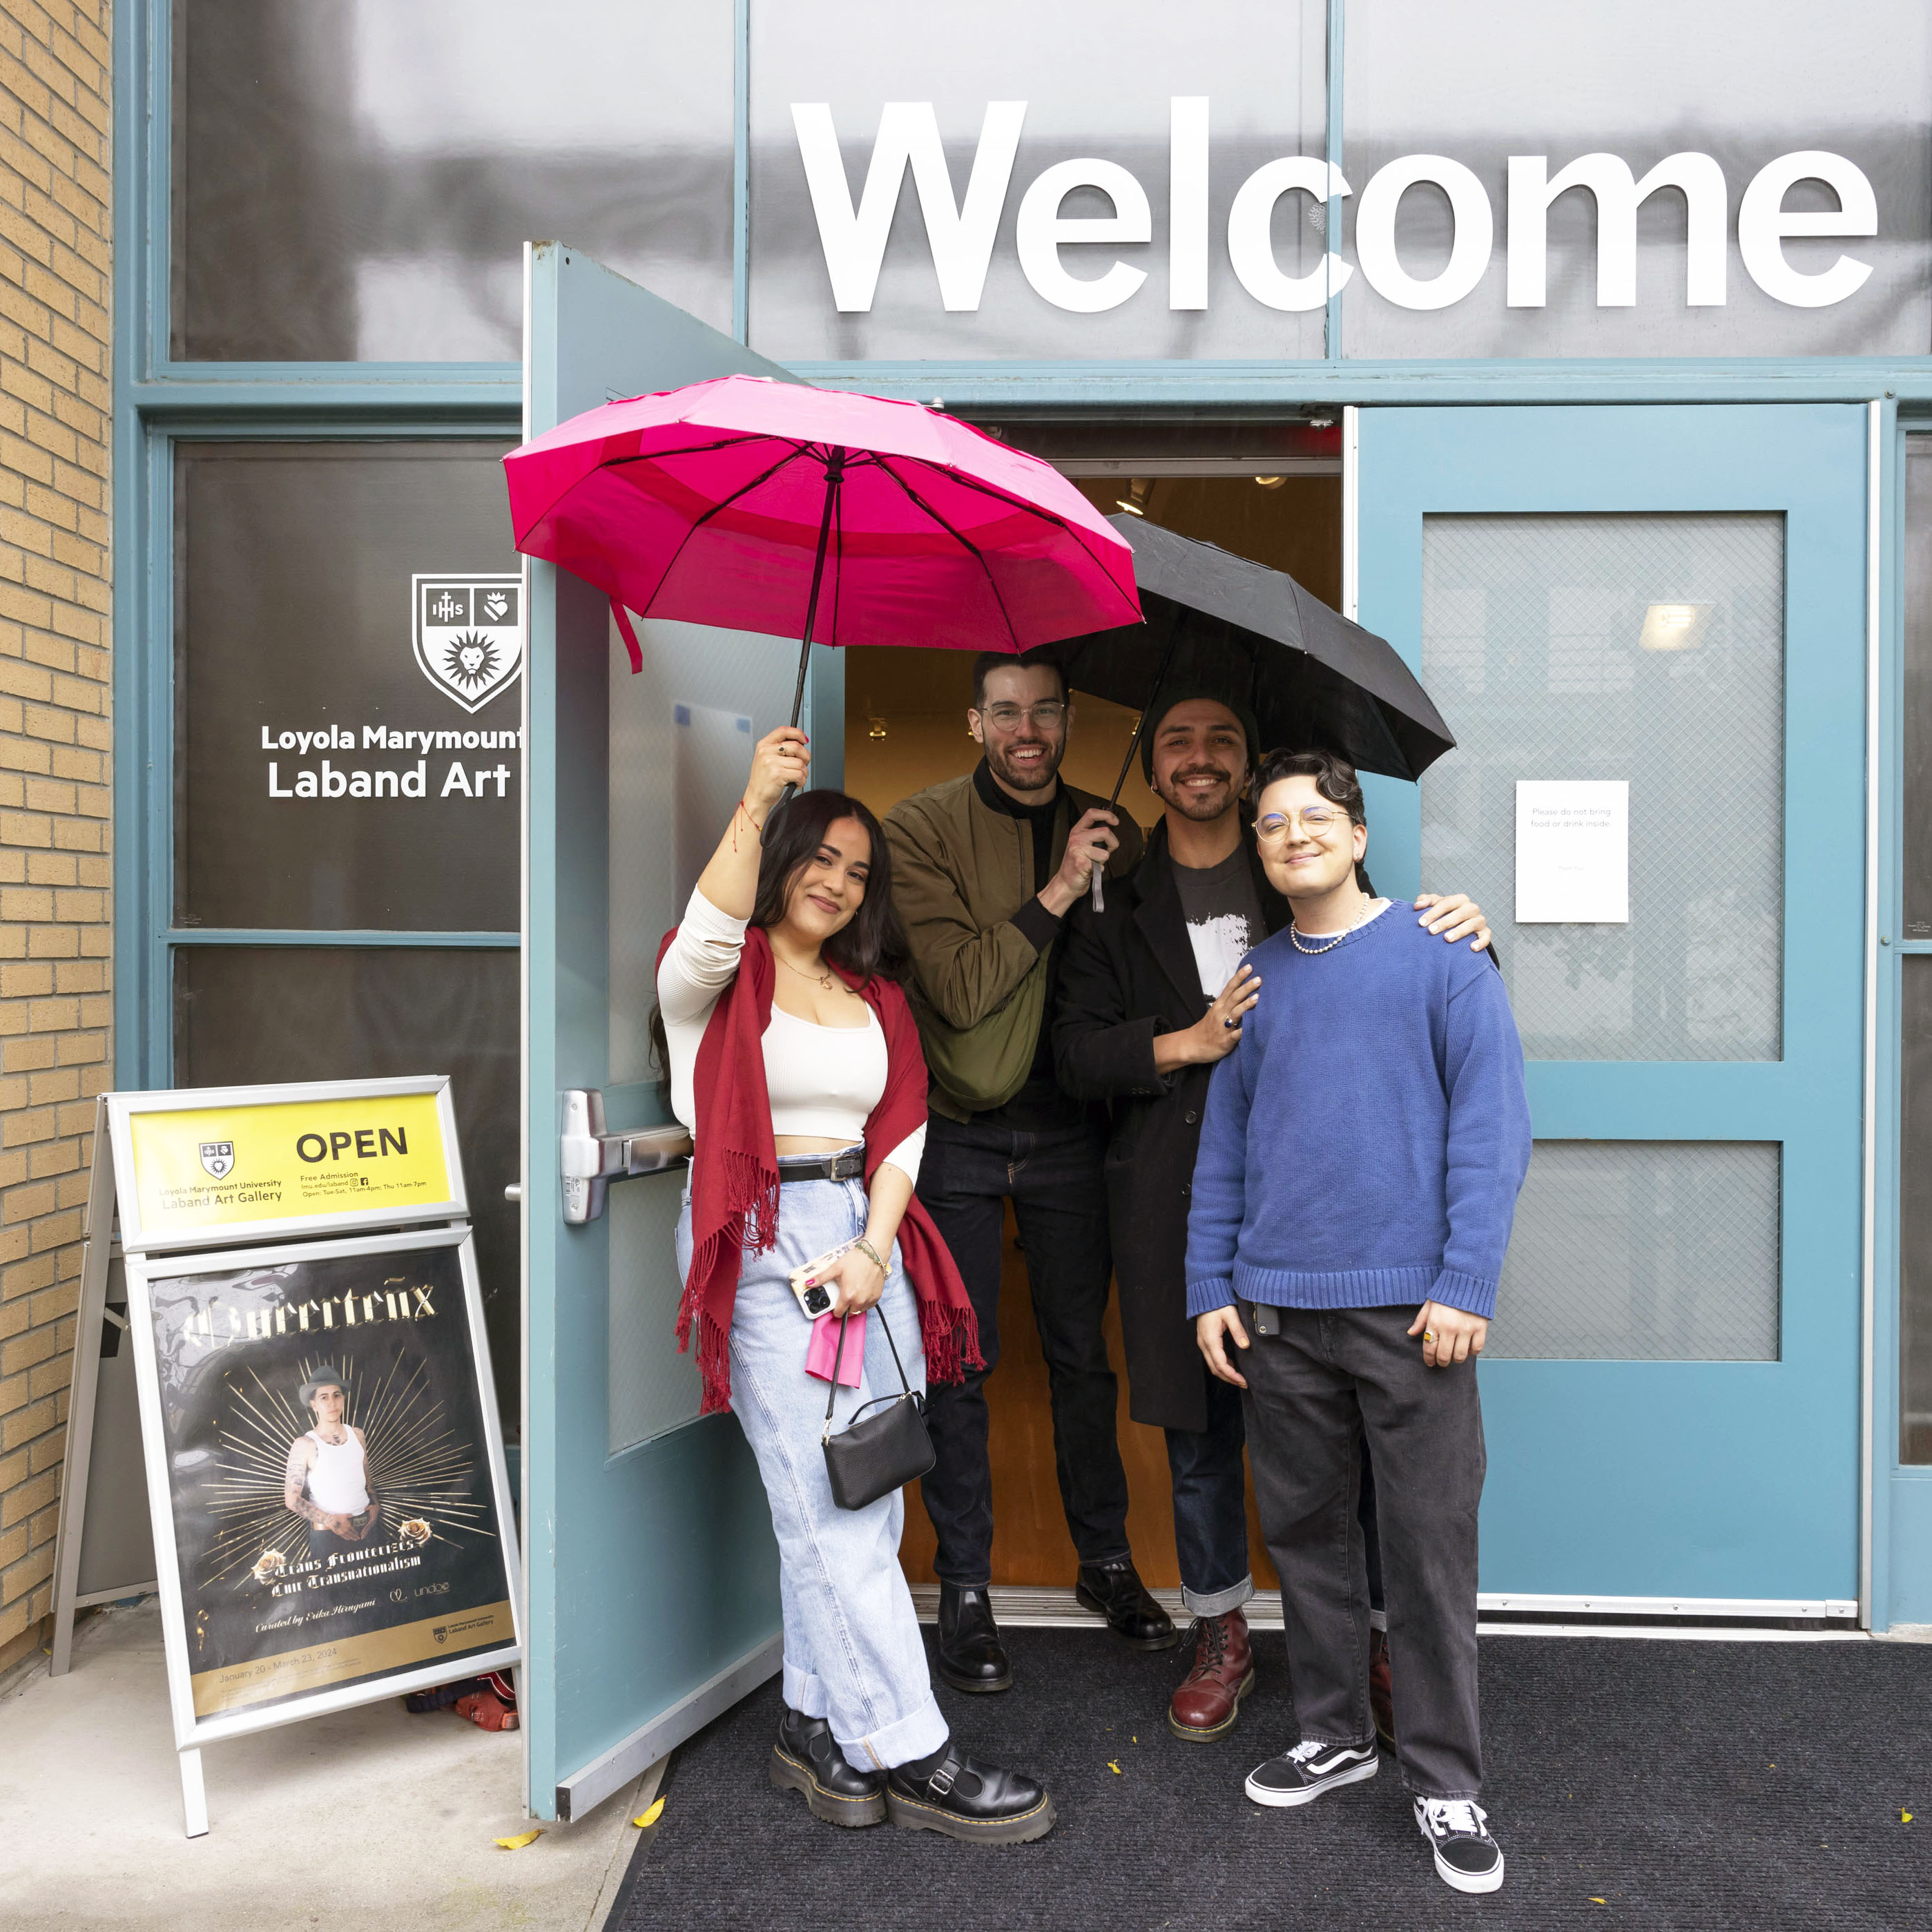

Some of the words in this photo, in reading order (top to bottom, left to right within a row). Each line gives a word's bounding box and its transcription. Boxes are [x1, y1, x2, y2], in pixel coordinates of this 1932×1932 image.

[790, 96, 1879, 313] Welcome
[262, 725, 355, 754] Loyola
[269, 760, 426, 798] Laband
[441, 762, 511, 798] Art
[1532, 808, 1558, 816] Please
[1561, 808, 1572, 816] do
[1590, 808, 1611, 817] bring
[296, 1127, 408, 1163] OPEN
[159, 1186, 187, 1196] Loyola
[189, 1184, 238, 1194] Marymount
[240, 1179, 282, 1189] University
[301, 1180, 349, 1189] lmu.edu/laband
[320, 1172, 358, 1180] Admission
[162, 1195, 210, 1210] Laband
[215, 1194, 234, 1205] Art
[238, 1190, 282, 1202] Gallery
[349, 1185, 382, 1193] 11am-4pm;
[307, 1556, 421, 1589] Transnationalism
[255, 1619, 291, 1634] Curated
[292, 1615, 304, 1625] by
[306, 1610, 330, 1621] Erika
[220, 1669, 253, 1683] January
[255, 1665, 265, 1674] 20
[273, 1657, 299, 1670] March
[302, 1654, 315, 1663] 23,
[317, 1648, 338, 1660] 2024
